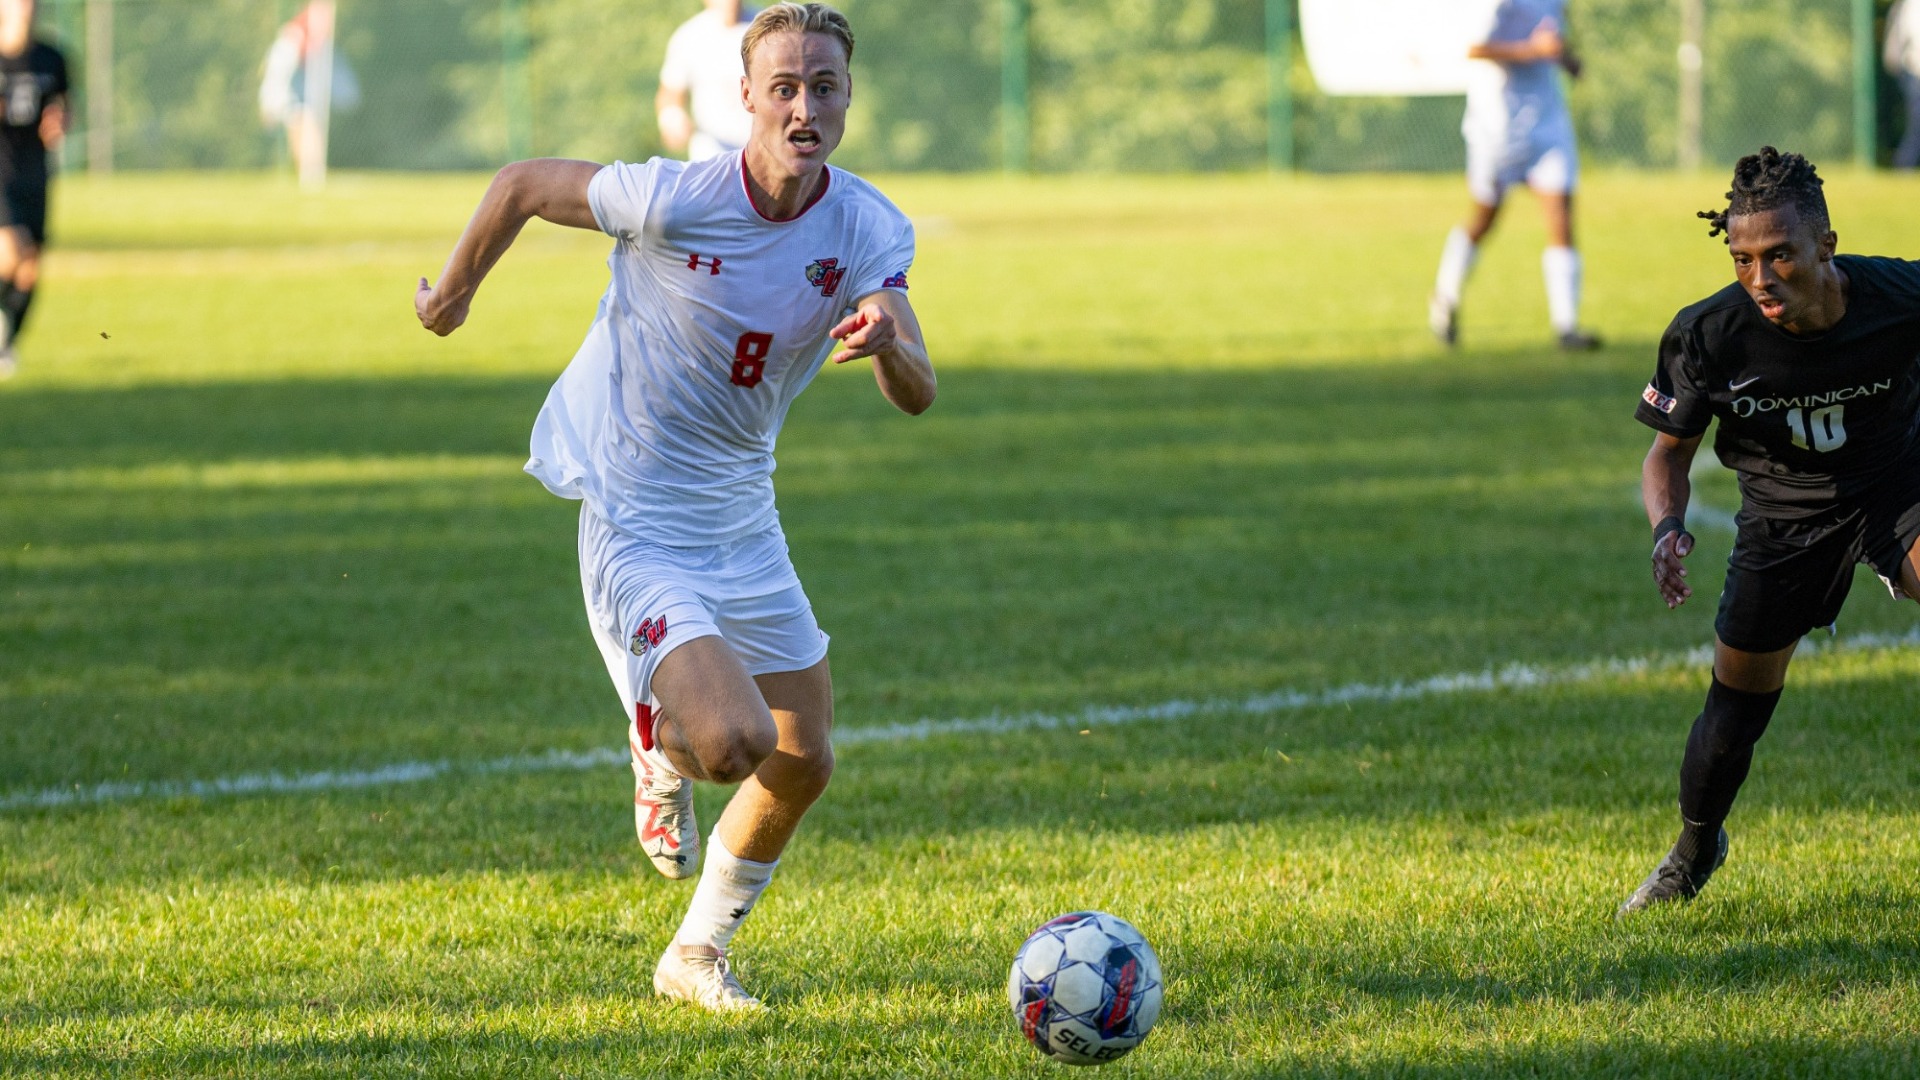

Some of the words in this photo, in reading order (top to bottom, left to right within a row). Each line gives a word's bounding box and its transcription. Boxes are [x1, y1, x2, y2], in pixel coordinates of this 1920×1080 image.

[730, 331, 774, 389] 8
[1731, 378, 1892, 418] DOMINICAN
[1786, 404, 1848, 453] 10
